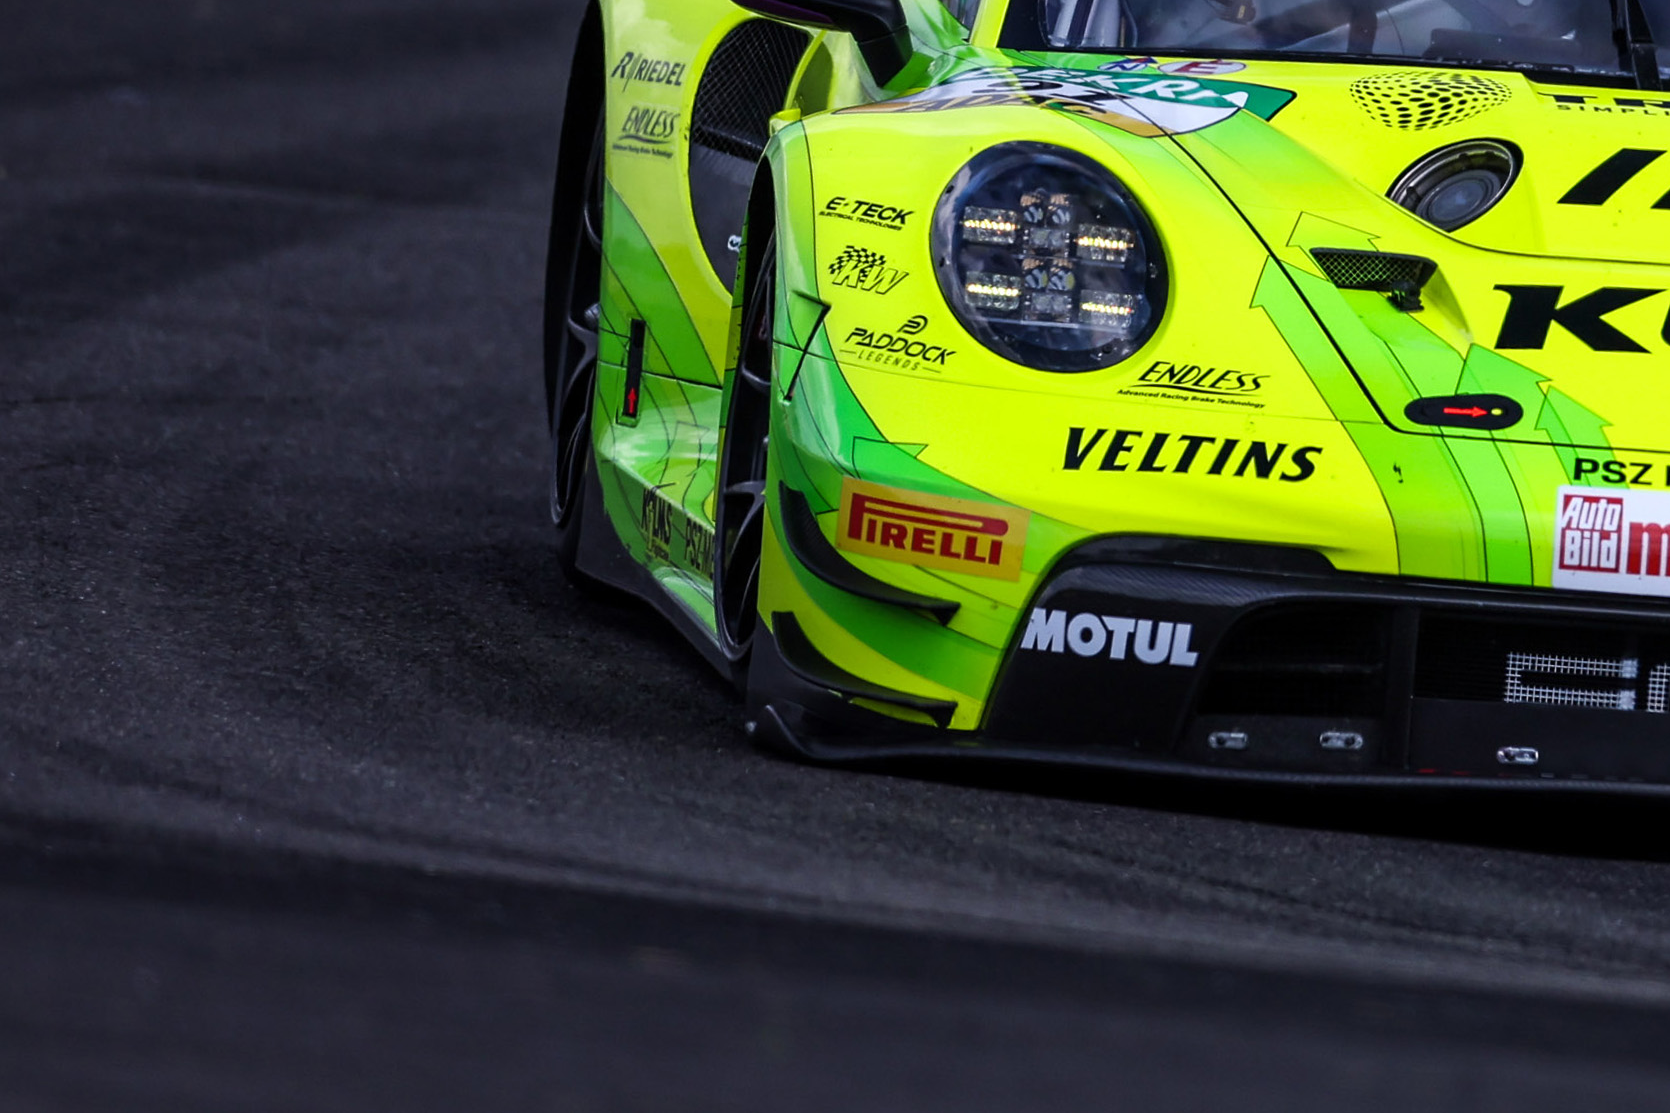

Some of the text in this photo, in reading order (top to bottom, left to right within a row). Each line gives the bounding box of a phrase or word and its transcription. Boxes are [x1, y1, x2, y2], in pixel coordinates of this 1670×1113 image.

[634, 59, 686, 86] RIEDEL
[622, 106, 681, 139] ENDLESS
[831, 259, 909, 295] KW
[845, 327, 957, 365] PADDOCK
[858, 348, 920, 371] LEGENDS
[1138, 361, 1271, 392] ENDLESS
[1117, 389, 1266, 409] Advanced Racing Brake Technology
[1062, 426, 1324, 483] VELTINS
[1573, 457, 1653, 485] PSZ
[847, 492, 1009, 566] PIRELLI
[1560, 496, 1622, 531] Auto
[1563, 529, 1618, 570] Bild
[1020, 606, 1199, 666] MOTUL
